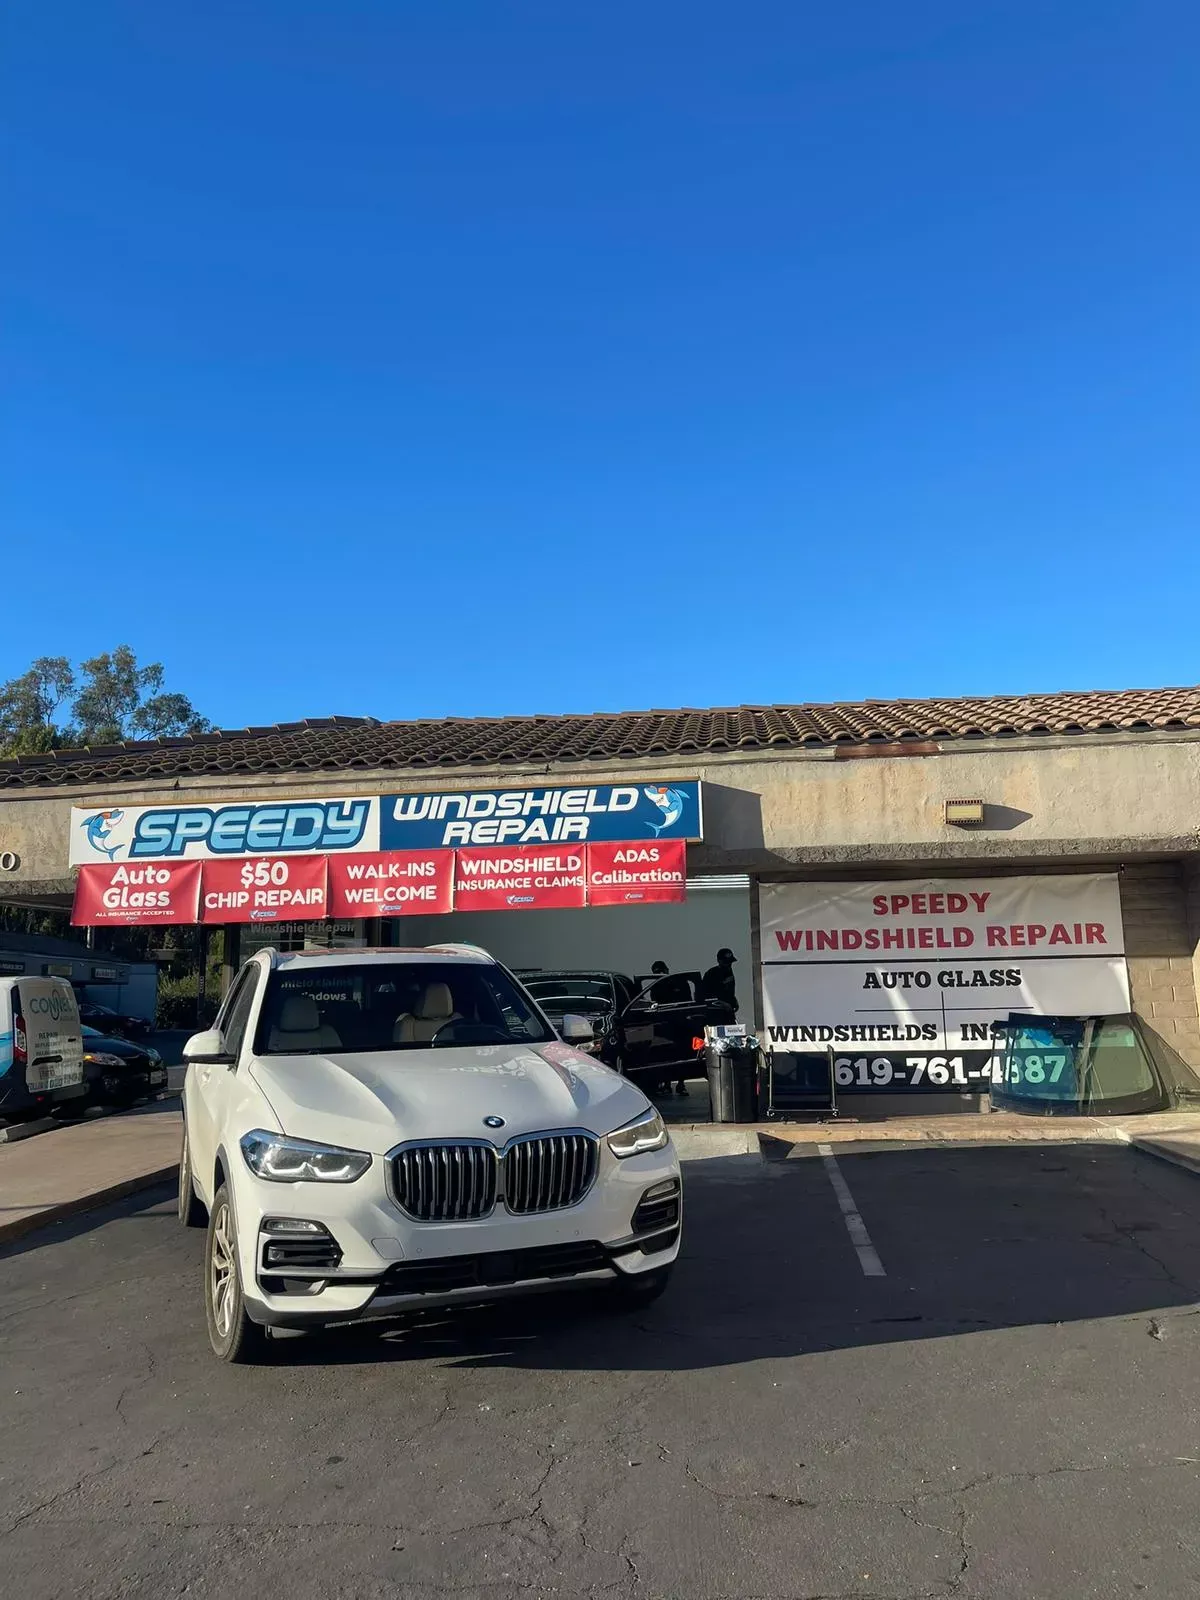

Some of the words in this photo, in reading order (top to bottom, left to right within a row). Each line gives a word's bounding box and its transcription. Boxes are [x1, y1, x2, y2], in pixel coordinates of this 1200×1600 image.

[392, 787, 639, 821] WINDSHIELD
[128, 800, 371, 858] SPEEDY
[442, 816, 590, 845] REPAIR
[461, 855, 581, 876] WINDSHIELD
[613, 848, 660, 864] ADAS
[110, 865, 170, 886] Auto
[240, 861, 289, 889] $50
[347, 861, 436, 880] WALK-INS
[591, 868, 683, 886] Calibration
[457, 877, 530, 891] INSURANCE
[534, 875, 584, 888] CLAIMS
[102, 887, 171, 909] Glass
[204, 892, 250, 909] CHIP
[254, 888, 324, 907] REPAIR
[344, 885, 437, 904] WELCOME
[873, 892, 992, 916] SPEEDY
[250, 921, 318, 934] Windshield
[318, 920, 354, 935] Repair
[775, 927, 974, 951] WINDSHIELD
[987, 923, 1108, 947] REPAIR
[863, 971, 931, 989] AUTO
[937, 969, 1022, 988] GLASS
[768, 1023, 938, 1042] WINDSHIELDS
